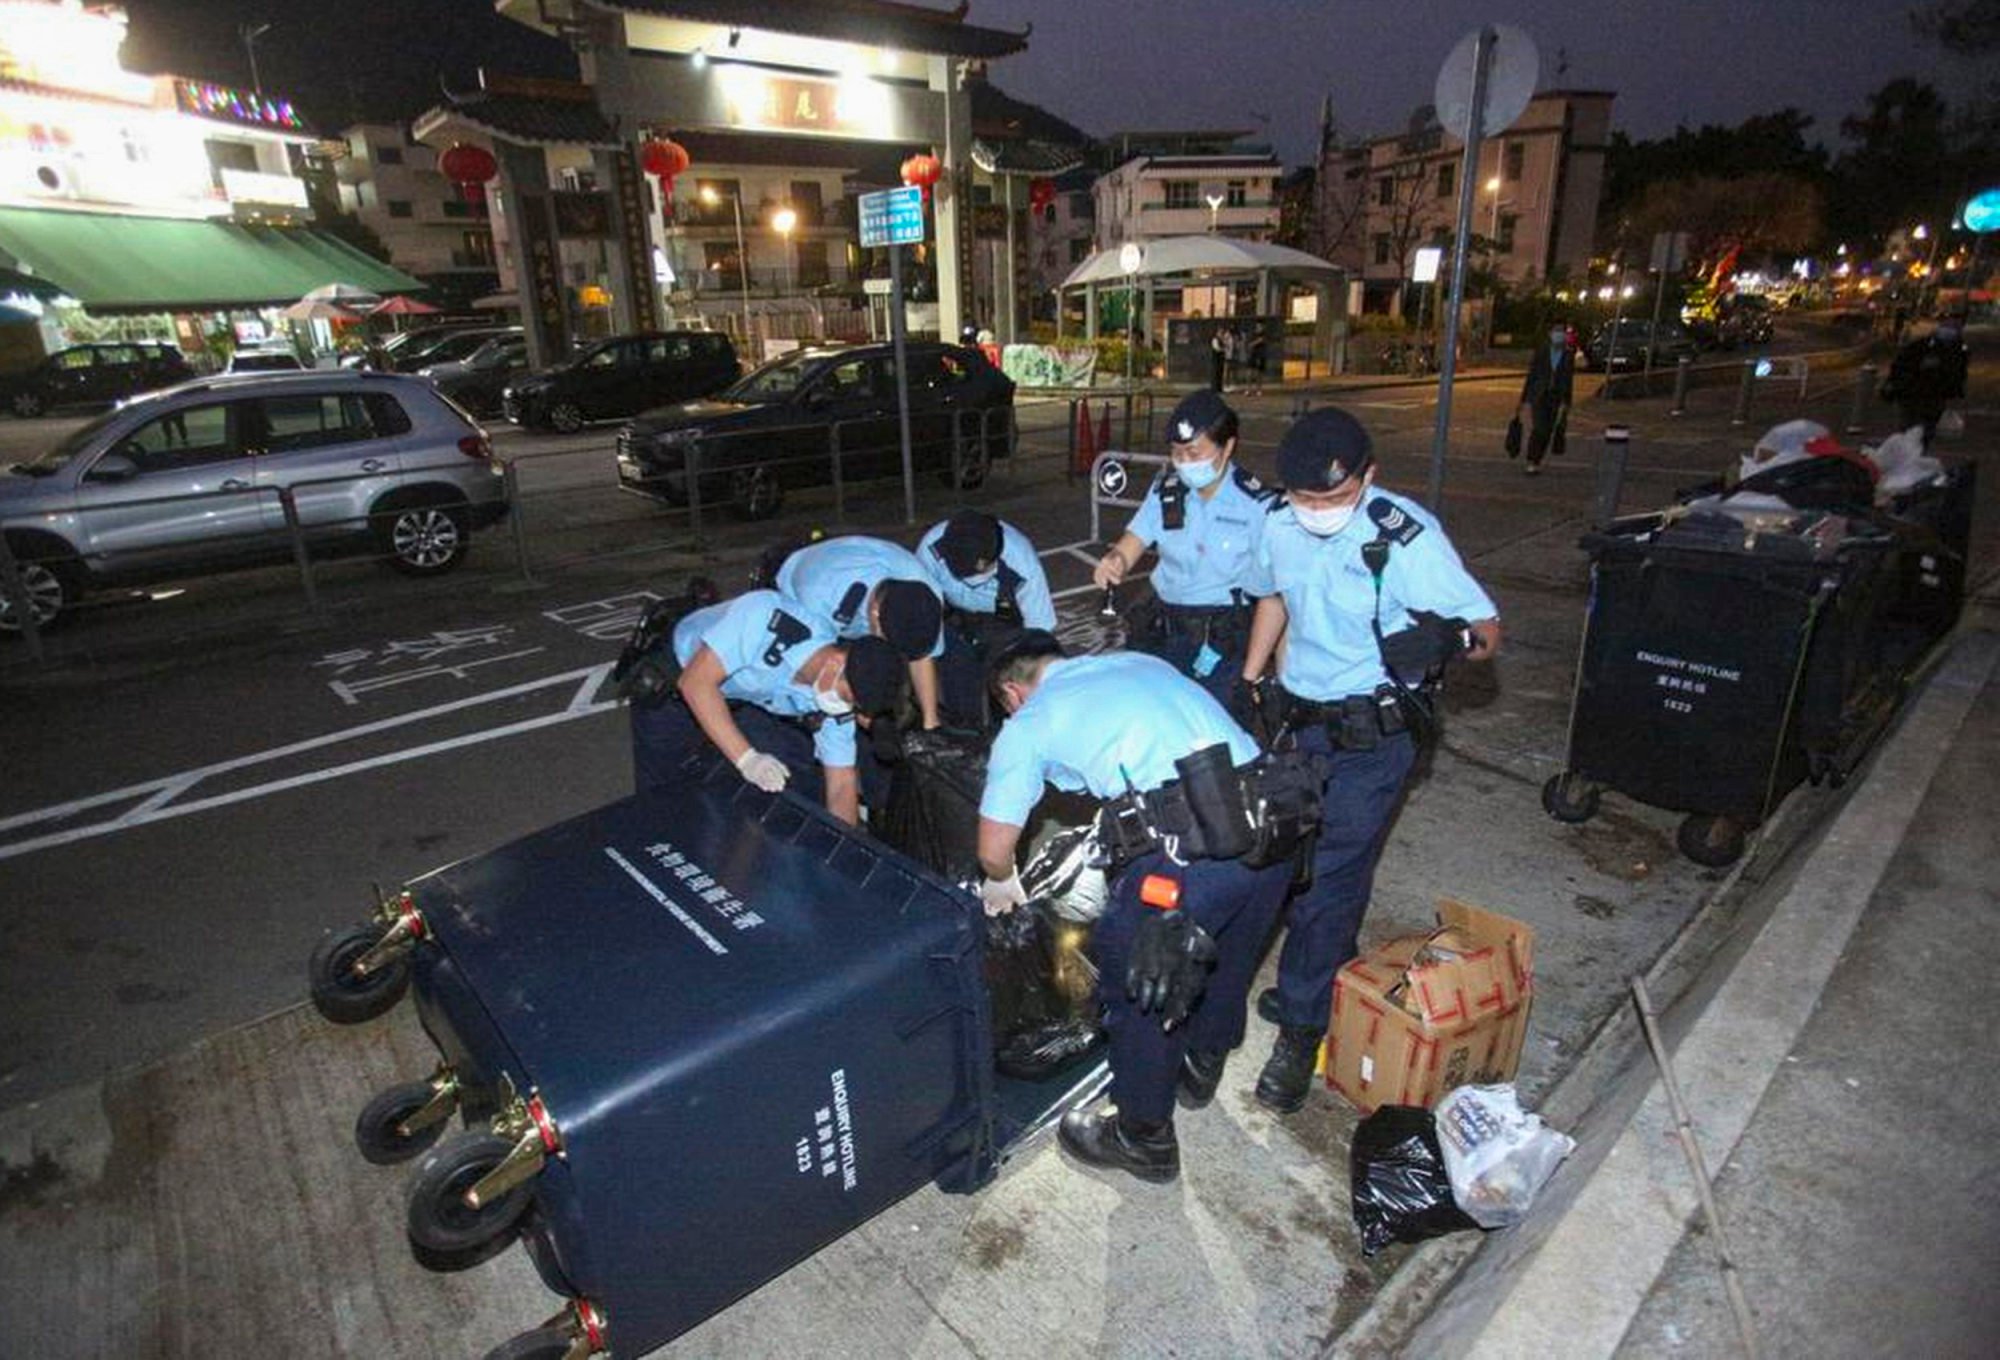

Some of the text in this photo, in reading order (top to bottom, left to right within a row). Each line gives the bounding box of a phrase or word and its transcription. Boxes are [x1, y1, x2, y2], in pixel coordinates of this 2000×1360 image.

[1636, 651, 1740, 681] ENQUIRY HOTLINE
[831, 1068, 857, 1191] ENQUIRY HOTLINE
[796, 1136, 812, 1173] 1823
